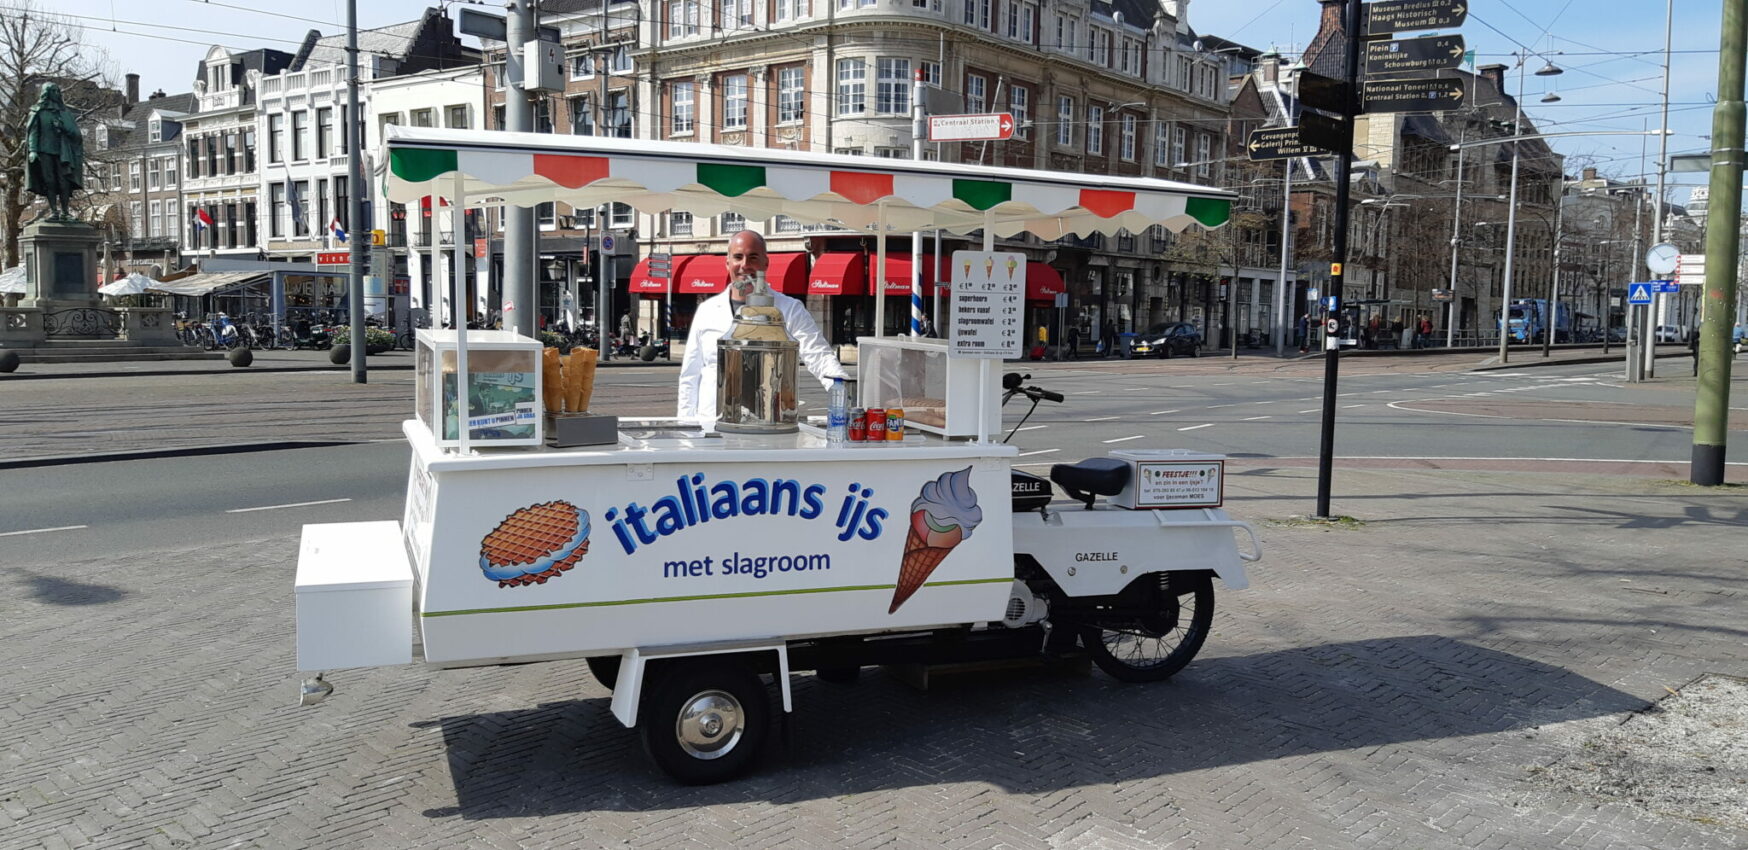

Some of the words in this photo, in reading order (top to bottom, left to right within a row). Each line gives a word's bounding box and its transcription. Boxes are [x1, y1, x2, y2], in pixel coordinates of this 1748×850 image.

[1372, 5, 1401, 13] Museum
[1403, 1, 1430, 9] Bredius
[1397, 10, 1437, 18] Historisch
[1394, 20, 1426, 28] Museum
[1369, 52, 1408, 61] Koninklijke
[1384, 60, 1427, 68] Schouwburg
[1366, 84, 1401, 92] Nationaal
[1260, 140, 1282, 148] Galerij
[294, 282, 336, 296] VIENA
[1012, 482, 1040, 492] ZELLE
[604, 472, 826, 555] italiaans
[836, 482, 889, 542] ijs
[1076, 552, 1118, 562] GAZELLE
[664, 556, 713, 578] met
[722, 552, 830, 578] slagroom
